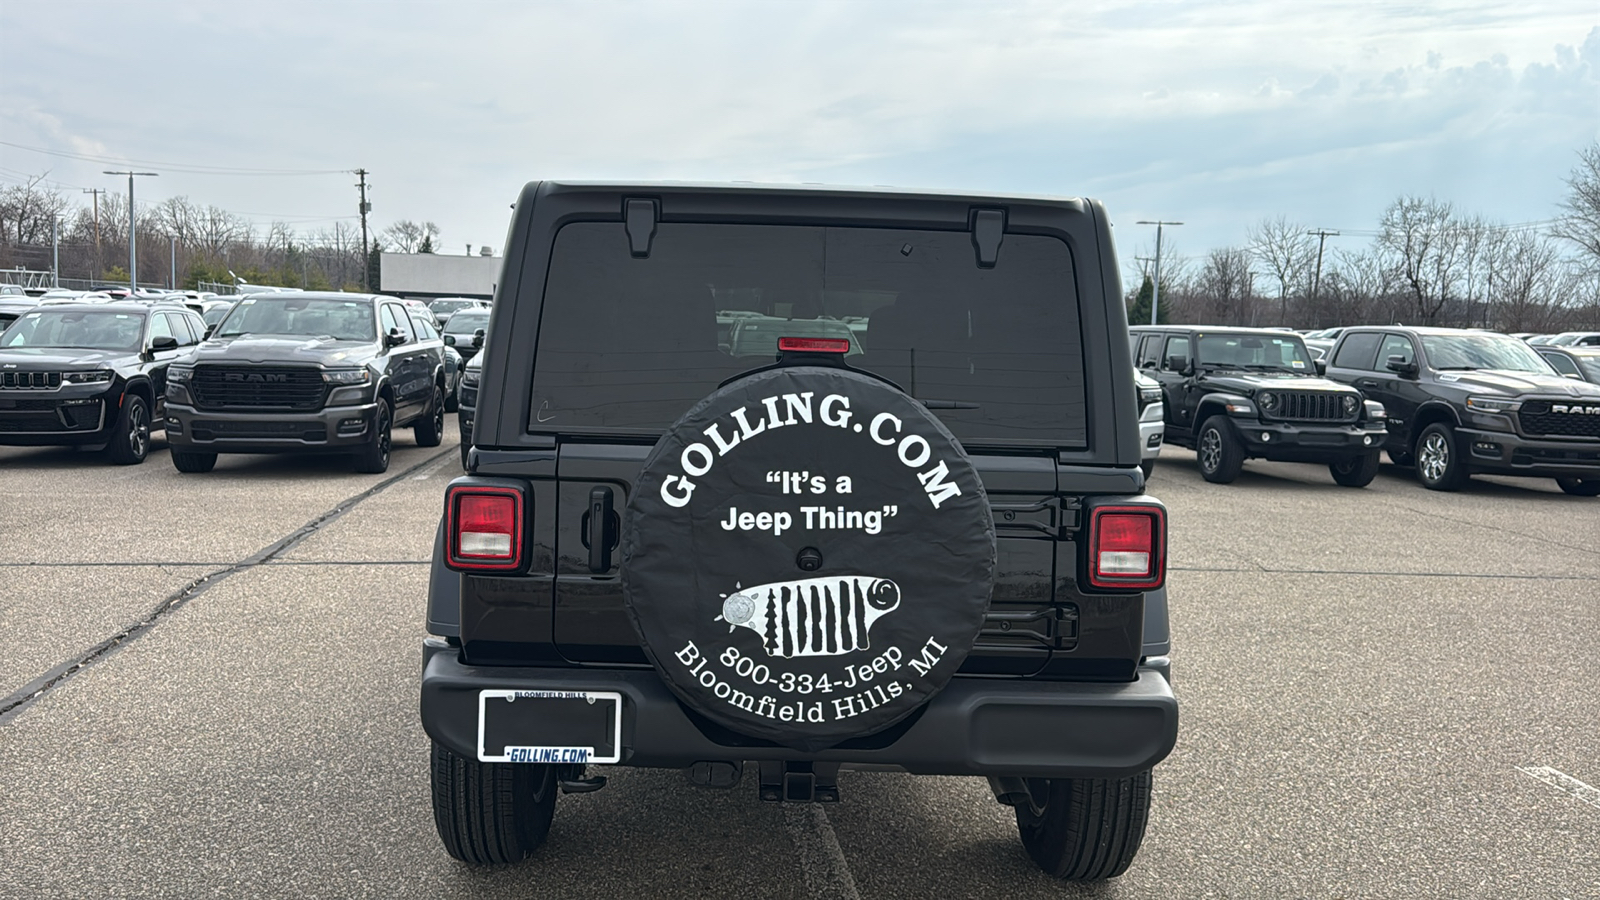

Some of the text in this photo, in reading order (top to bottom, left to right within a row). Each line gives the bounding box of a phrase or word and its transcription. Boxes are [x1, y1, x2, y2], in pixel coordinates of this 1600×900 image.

[225, 373, 287, 382] RAM
[1552, 404, 1600, 415] RAM
[660, 391, 962, 510] GOLLING.COM
[835, 475, 852, 494] a
[720, 504, 898, 536] Jeep Thing”
[719, 644, 903, 695] 800-334-Jeep
[674, 635, 949, 724] Bloomfield Hills, MI
[514, 691, 587, 700] BLOOMFIELD HILLS
[510, 748, 588, 763] GOLLING.COM
